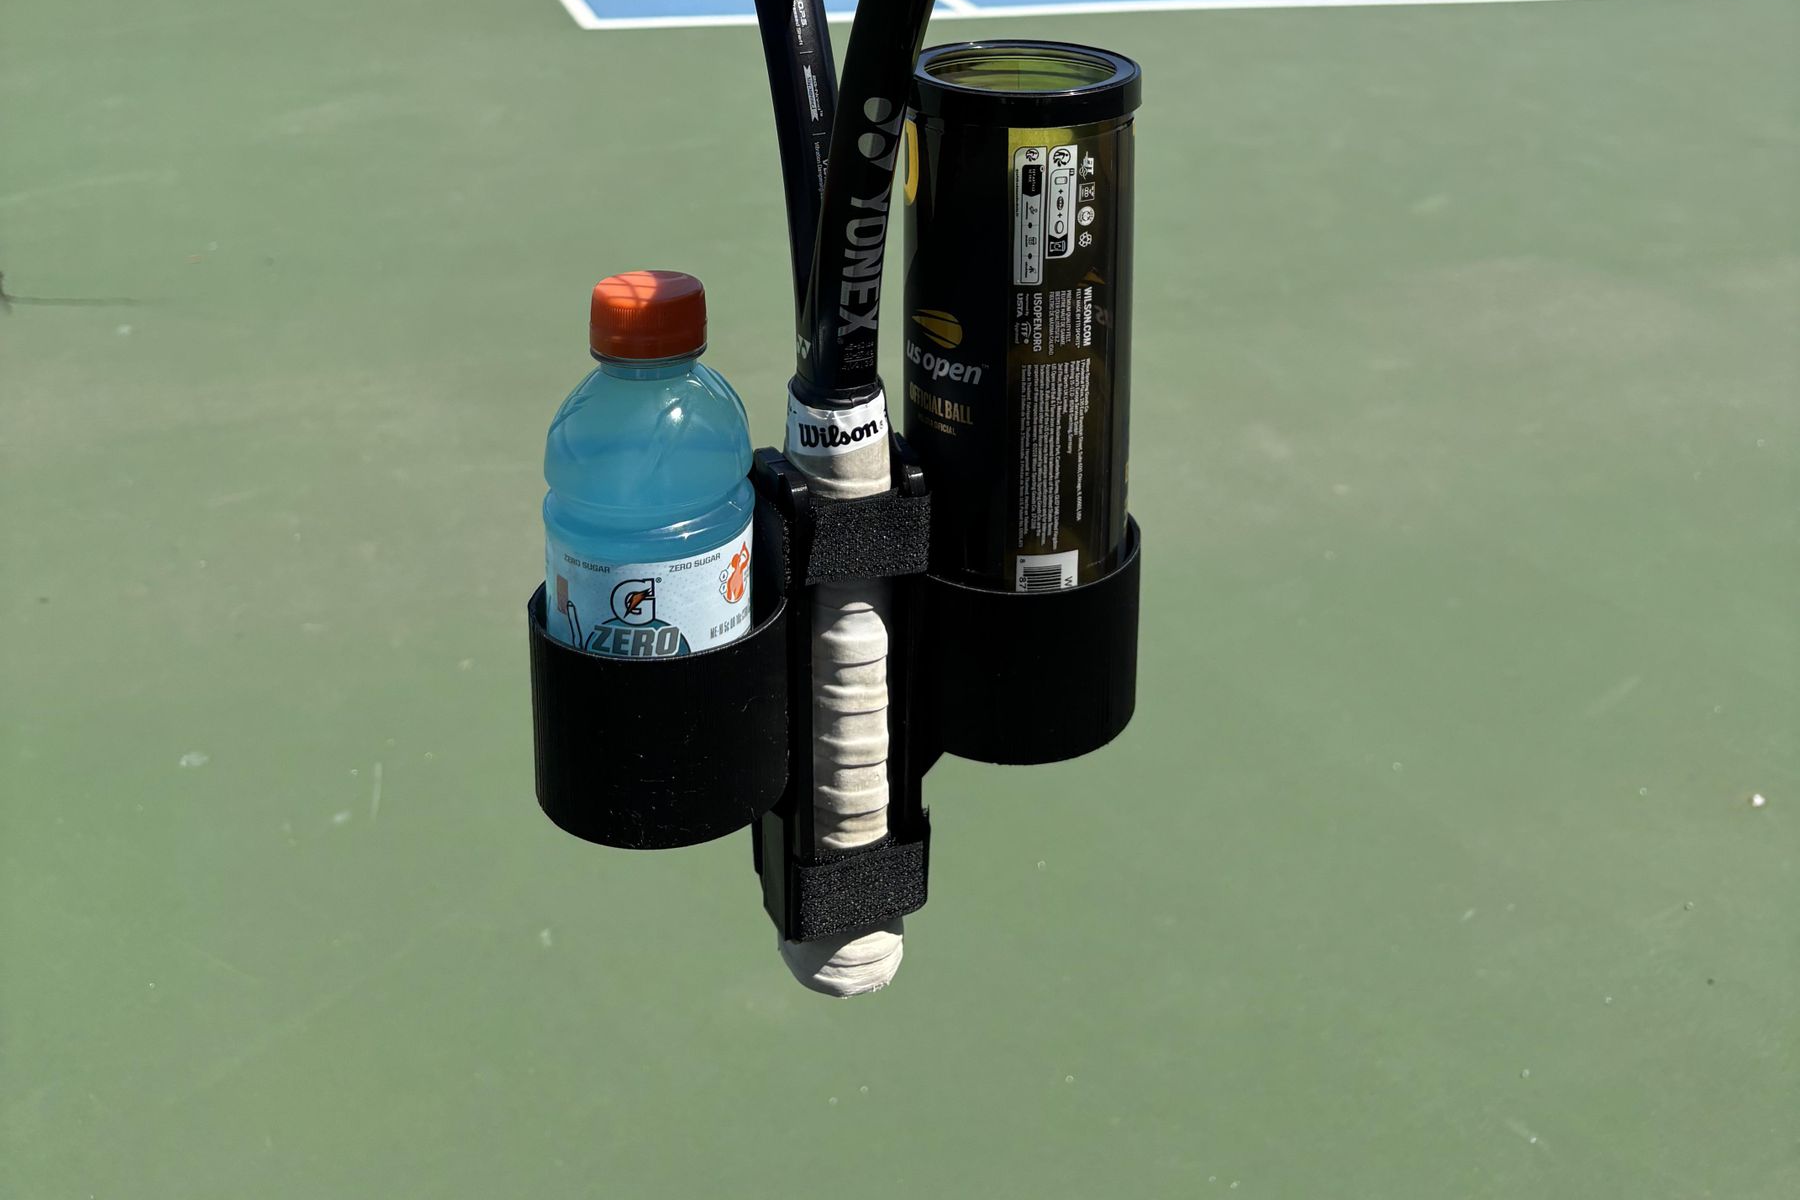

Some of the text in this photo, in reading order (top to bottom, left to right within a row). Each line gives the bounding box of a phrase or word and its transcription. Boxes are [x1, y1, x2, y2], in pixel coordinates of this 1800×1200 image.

[838, 183, 892, 336] YONEX
[1016, 293, 1024, 318] USTA
[1033, 292, 1043, 352] USOPEN.ORG
[1083, 286, 1093, 347] WILSON.COM
[906, 340, 922, 365] us
[922, 352, 983, 385] open
[909, 382, 944, 417] OFFICIAL
[944, 400, 974, 425] BALL
[798, 419, 879, 448] Wilson
[564, 554, 611, 574] ZERO SUGAR
[669, 552, 721, 573] ZERO SUGAR
[591, 624, 681, 658] ZERO
